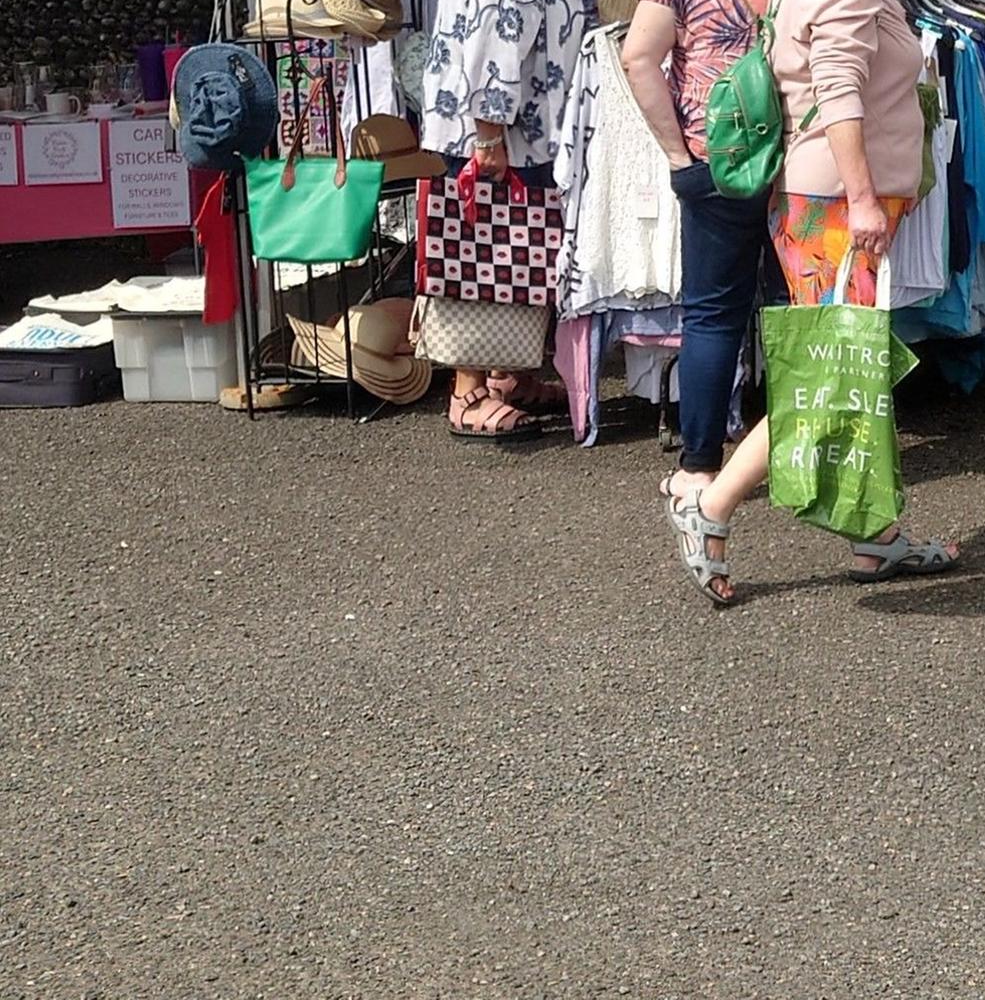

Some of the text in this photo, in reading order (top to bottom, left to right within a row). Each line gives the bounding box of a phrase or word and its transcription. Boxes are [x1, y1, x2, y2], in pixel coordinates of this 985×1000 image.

[133, 128, 164, 142] CAR
[115, 151, 183, 166] STICKERS
[120, 171, 178, 184] DECORATIVE
[128, 187, 172, 199] STICKERS
